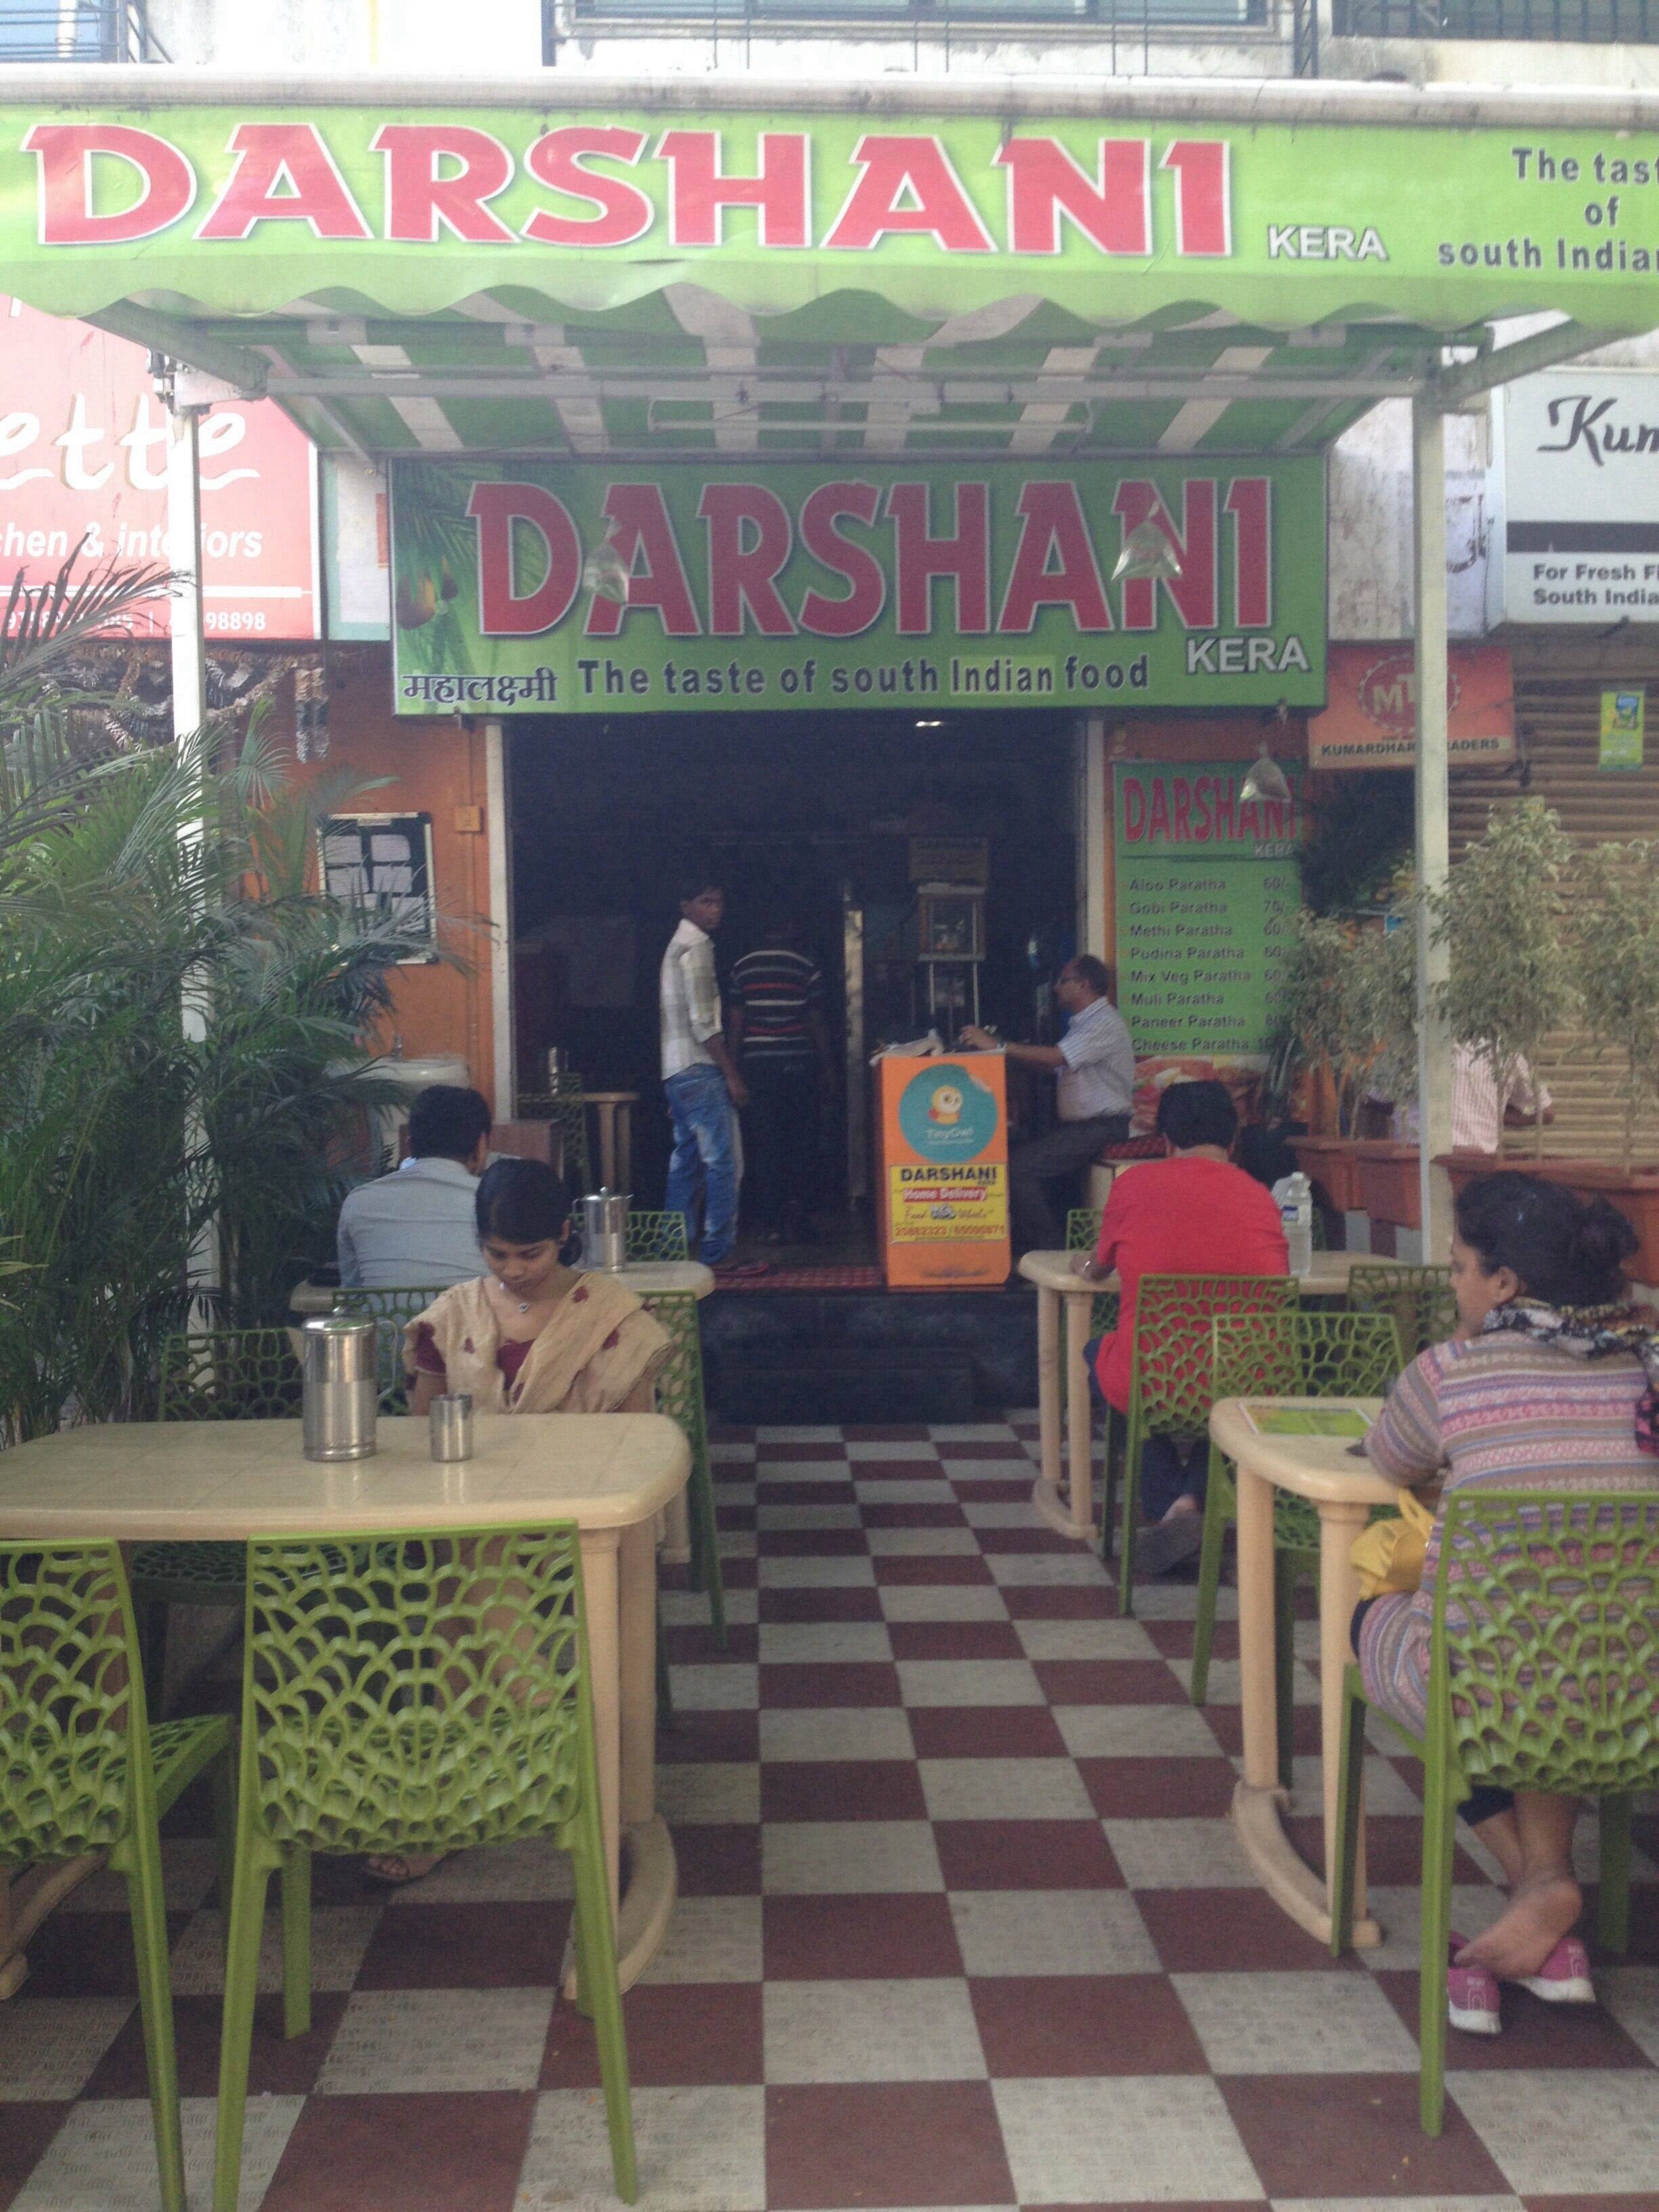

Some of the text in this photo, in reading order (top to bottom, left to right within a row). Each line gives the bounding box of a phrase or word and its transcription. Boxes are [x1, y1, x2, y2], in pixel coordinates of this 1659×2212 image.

[1511, 147, 1579, 181] The
[20, 122, 1231, 256] DARSHANI
[1584, 194, 1619, 227] of
[1267, 225, 1389, 262] KERA
[1438, 237, 1659, 271] south India
[0, 521, 264, 558] hen & intiors
[465, 476, 1271, 637] DARSHANI
[1534, 563, 1569, 580] For
[1576, 563, 1636, 580] Fresh
[1534, 588, 1597, 605] South
[1186, 635, 1313, 673] KERA
[577, 655, 1149, 695] The taste of south Indian food
[403, 666, 558, 705] महालक्ष्मी
[1168, 878, 1226, 890] Paratha
[1170, 901, 1227, 914] Paratha
[1130, 924, 1171, 937] Methi
[1175, 924, 1233, 936] Paratha
[1130, 947, 1183, 960] Pudina
[1187, 947, 1244, 960] Paratha
[1130, 970, 1155, 983] Mix
[1162, 970, 1189, 985] Veg
[1193, 969, 1252, 982] Paratha
[1130, 992, 1162, 1006] Muli
[1167, 992, 1225, 1004] Paratha
[1131, 1015, 1245, 1028] Paneer Paratha
[1132, 1038, 1187, 1051] Cheese
[1192, 1038, 1249, 1050] Paratha
[900, 1166, 998, 1182] DARSHANI
